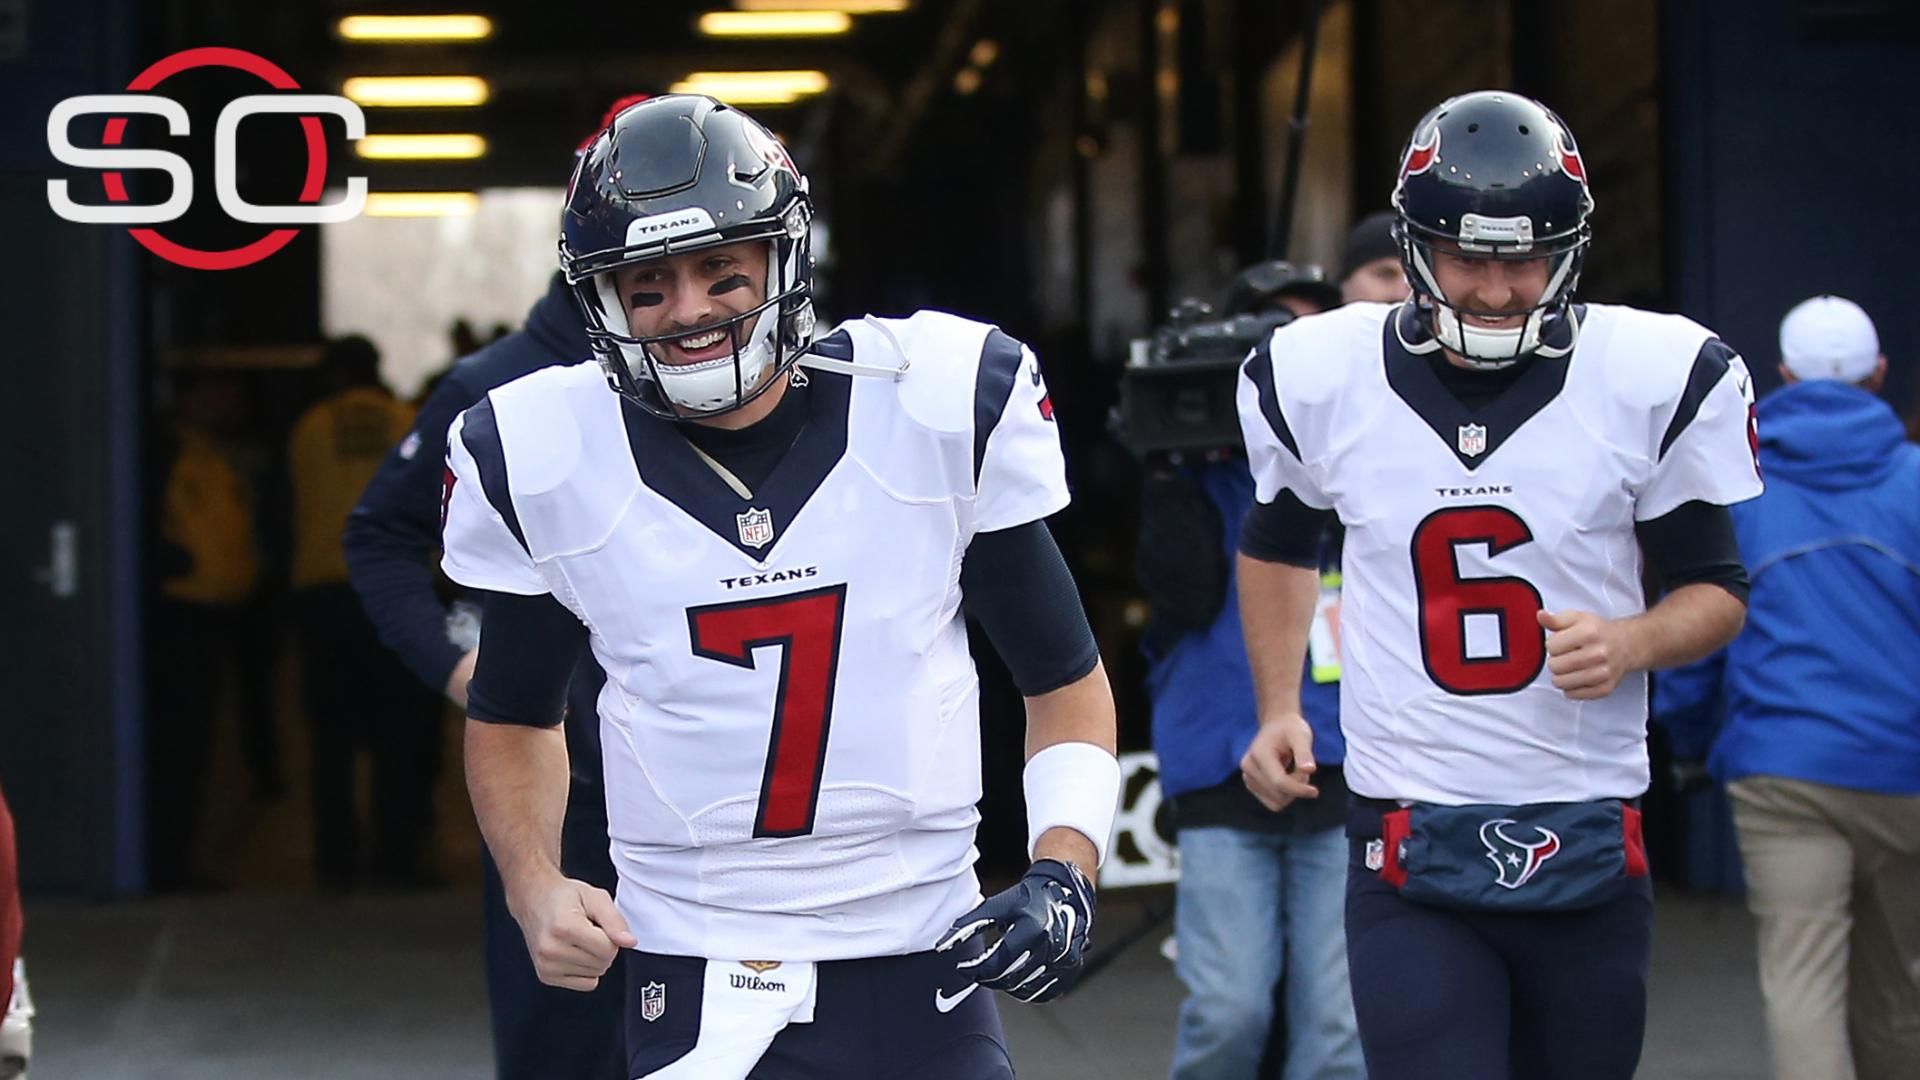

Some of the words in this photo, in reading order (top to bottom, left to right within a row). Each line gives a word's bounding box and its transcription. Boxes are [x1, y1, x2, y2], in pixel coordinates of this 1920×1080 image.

[639, 217, 700, 234] TEXANS
[1436, 485, 1513, 497] TEXANS
[744, 524, 769, 541] NFL
[720, 566, 817, 590] TEXANS
[1410, 504, 1547, 696] 6
[685, 582, 848, 839] 7
[729, 974, 786, 993] Wilson
